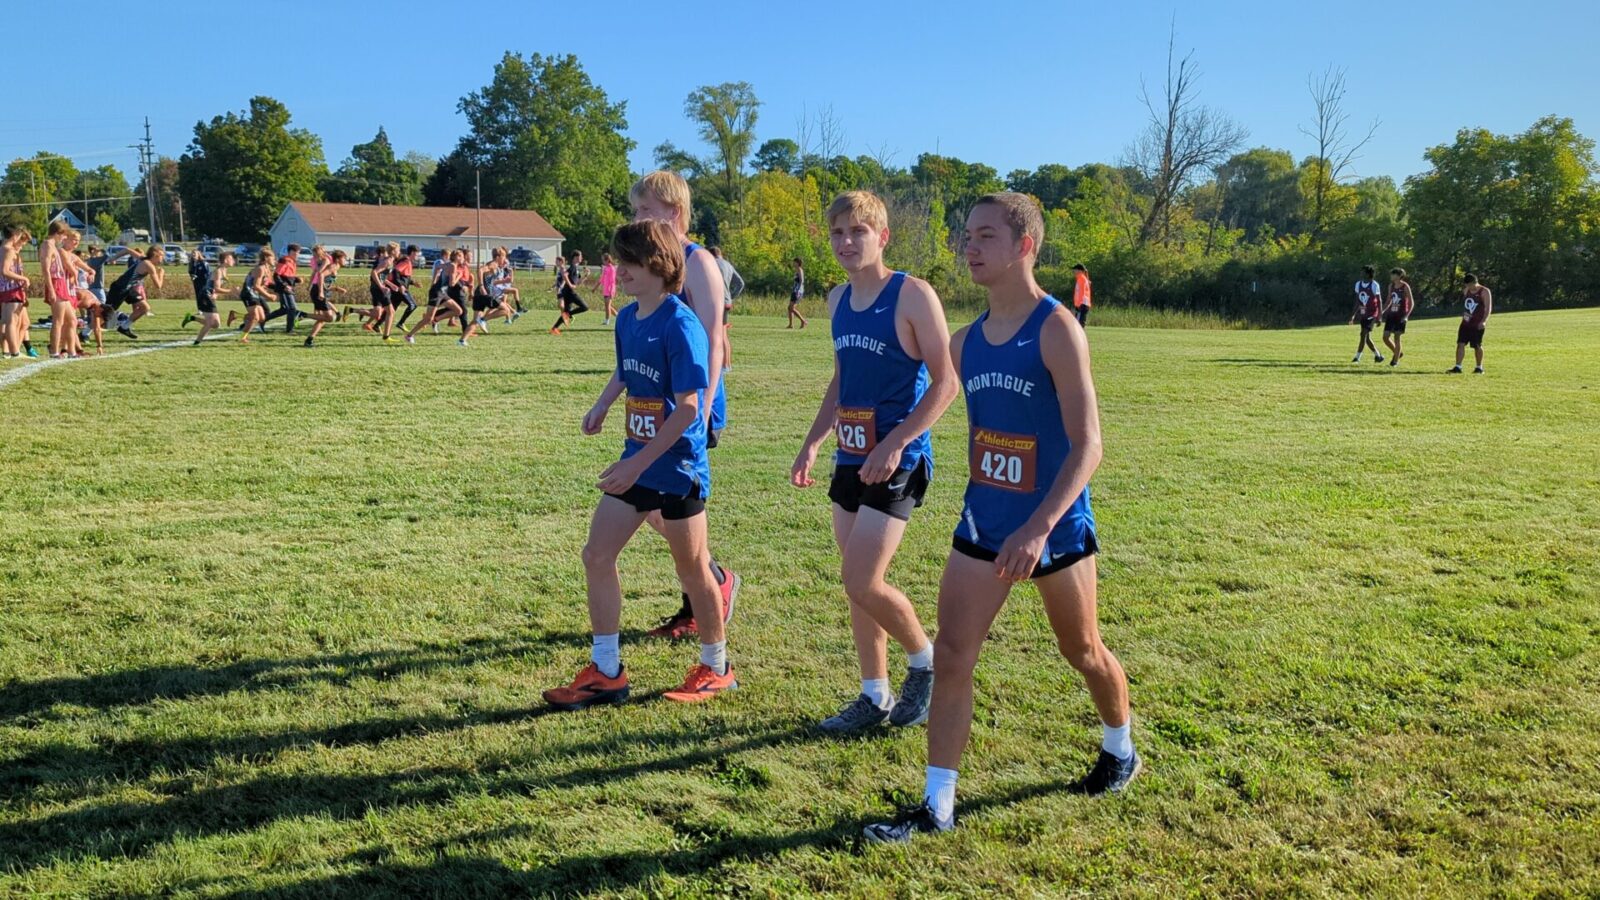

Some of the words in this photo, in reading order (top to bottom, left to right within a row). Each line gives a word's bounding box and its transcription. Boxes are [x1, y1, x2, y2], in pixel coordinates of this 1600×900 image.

[623, 358, 660, 383] ONTAGUE
[966, 372, 1034, 397] MONTAGUE
[629, 413, 656, 438] 425
[981, 451, 1022, 484] 420
